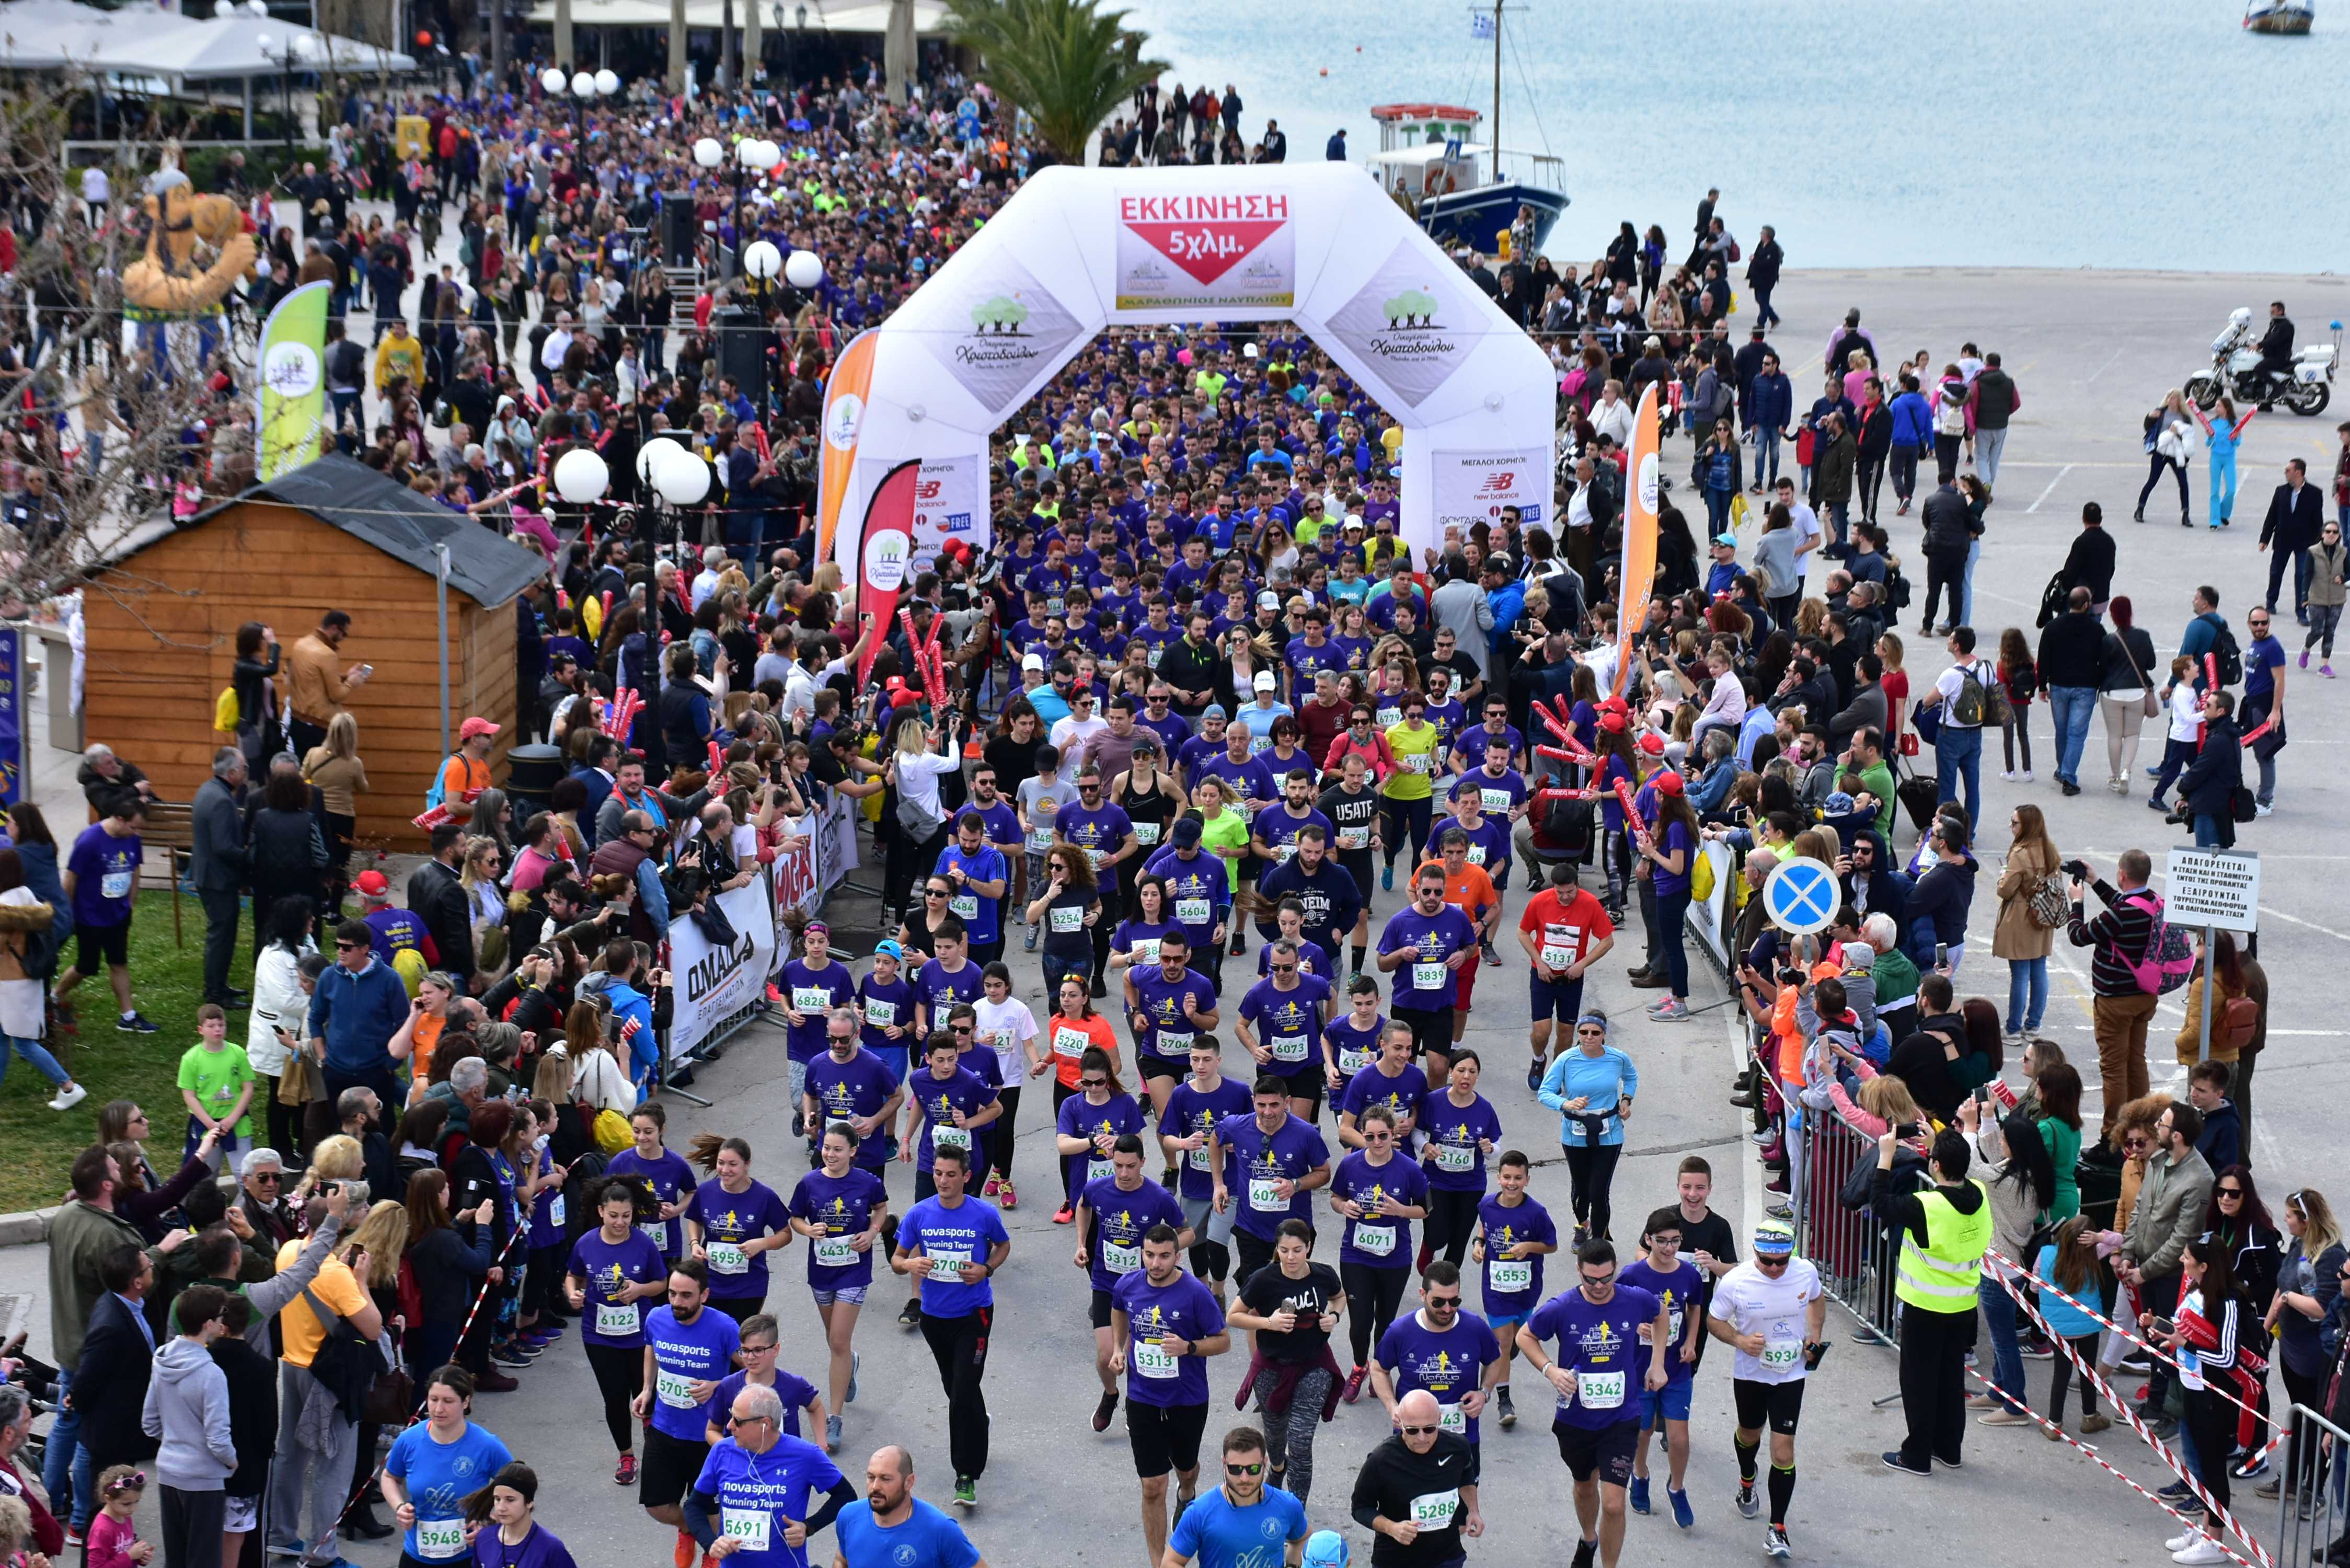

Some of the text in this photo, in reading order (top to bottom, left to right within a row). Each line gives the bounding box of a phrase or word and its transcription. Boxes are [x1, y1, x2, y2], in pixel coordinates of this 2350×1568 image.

[1121, 194, 1288, 220] ΕΚΚΙΝΗΣΗ
[1169, 228, 1244, 260] 5χλμ.
[1124, 296, 1287, 306] ΜΑΡΑΘΩΝΙΟΣ ΝΑΥΠΛΙΟΥ
[1370, 338, 1454, 356] Χριστοδούλου
[1523, 507, 1539, 520] FREE
[950, 514, 971, 529] FREE
[1439, 516, 1486, 525] ΦΟΥΓΑΡΟ
[1379, 714, 1400, 724] 6779
[1257, 741, 1272, 750] 558
[1542, 746, 1563, 755] balance
[1484, 795, 1506, 805] 5898
[1621, 788, 1634, 816] balance
[1336, 799, 1372, 821] USATF
[1034, 835, 1051, 843] 548
[2182, 857, 2245, 871] ΑΠΑΓΟΡΕΥΕΤΑΙ
[2217, 871, 2253, 881] ΣΤΑΘΜΕΥΣΗ
[2210, 879, 2248, 889] ΠΡΟΒΛΗΤΑΣ
[2182, 886, 2240, 901] ΕΞΑΙΡΟΥΝΤΑΙ
[951, 902, 974, 912] 5484
[2173, 895, 2247, 910] ΤΟΥΡΙΣΤΙΚΑ ΛΕΩΦΟΡΕΙΑ
[1180, 906, 1206, 916] 5604
[2185, 905, 2224, 915] ΟΛΙΓΟΛΕΠΤΗ
[1053, 914, 1080, 924] 5254
[1545, 952, 1571, 963] 5131
[1417, 970, 1444, 981] 5839
[797, 996, 825, 1007] 6828
[1057, 1035, 1082, 1050] 5220
[1160, 1039, 1189, 1050] 5704
[1277, 1043, 1305, 1054] 6073
[1343, 1057, 1363, 1068] 612
[938, 1135, 966, 1145] 6459
[1439, 1152, 1469, 1165] 5160
[1253, 1190, 1276, 1201] 607
[921, 1228, 976, 1238] novasports
[1105, 1226, 1138, 1237] Nafplio
[923, 1240, 974, 1251] Running Team
[1358, 1233, 1390, 1247] 6071
[820, 1245, 850, 1256] 6437
[710, 1251, 744, 1264] 5959
[1106, 1251, 1136, 1266] 5312
[1495, 1270, 1527, 1282] 6553
[601, 1312, 634, 1326] 6122
[655, 1340, 710, 1357] novasports
[1582, 1343, 1620, 1354] Nafplio
[655, 1354, 710, 1369] Running Team
[1138, 1353, 1172, 1367] 5313
[1765, 1349, 1798, 1363] 5934
[1419, 1373, 1459, 1382] Nafplio
[660, 1379, 690, 1398] 5703
[1585, 1381, 1621, 1397] 5342
[724, 1482, 787, 1496] novasports
[723, 1495, 784, 1508] Running Team
[1418, 1503, 1455, 1519] 5288
[724, 1519, 762, 1537] 5691
[422, 1530, 460, 1546] 5948
